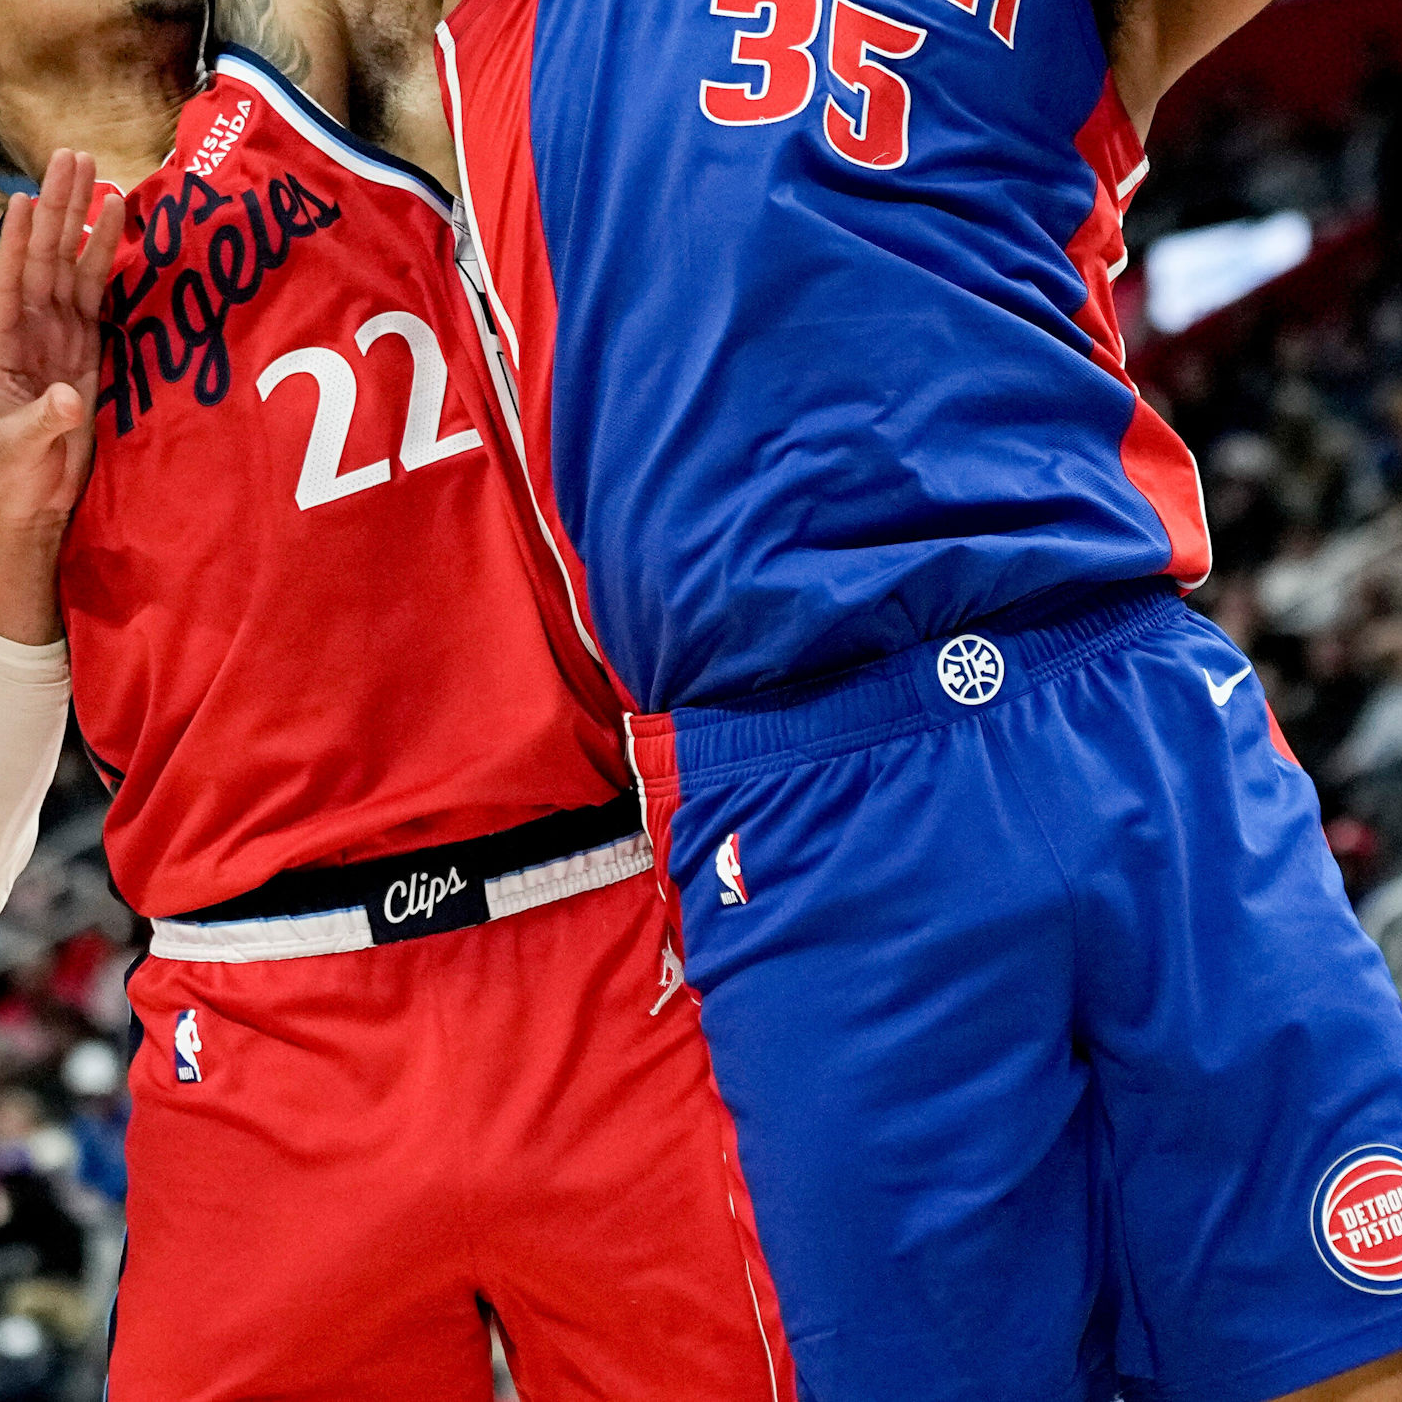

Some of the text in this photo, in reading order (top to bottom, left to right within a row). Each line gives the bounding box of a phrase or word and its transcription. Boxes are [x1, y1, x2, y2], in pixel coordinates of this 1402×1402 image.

[184, 113, 230, 173] VISIT
[256, 311, 484, 512] 22
[384, 866, 467, 924] Clips
[720, 890, 738, 906] NBA
[178, 1066, 195, 1081] NBA
